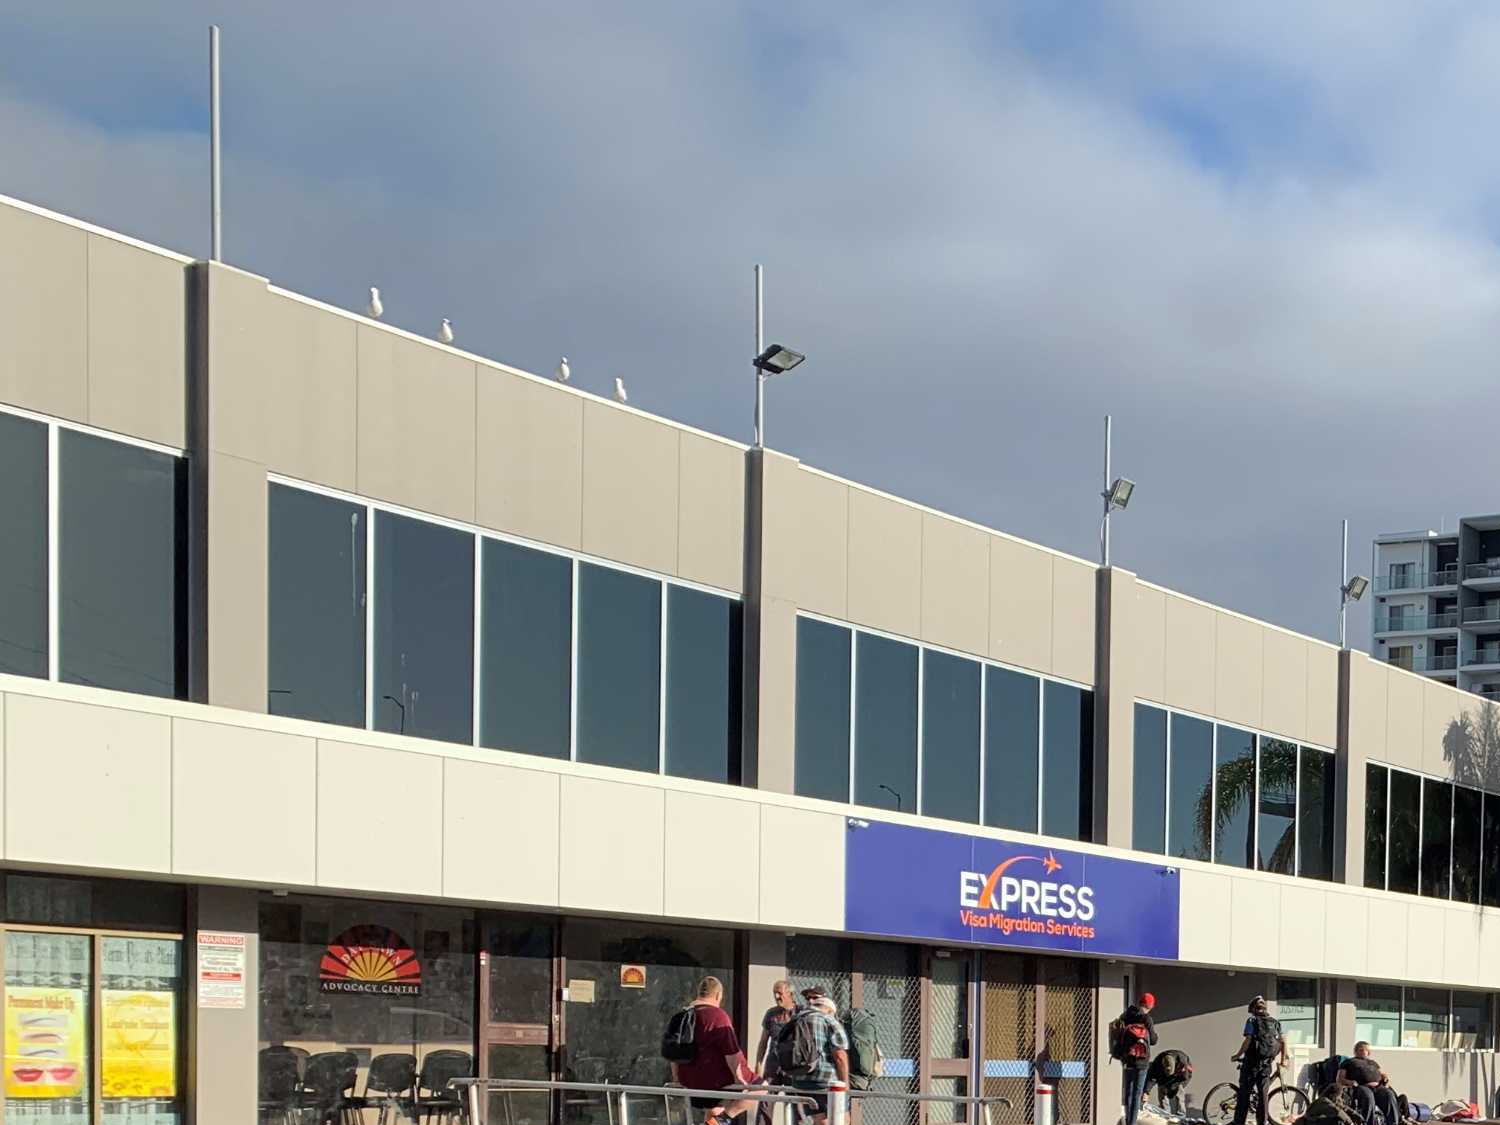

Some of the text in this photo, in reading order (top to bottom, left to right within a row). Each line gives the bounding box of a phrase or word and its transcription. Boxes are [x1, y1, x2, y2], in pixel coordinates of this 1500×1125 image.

[960, 871, 1095, 921] EXPRESS
[960, 910, 1095, 938] Visa Migration Services
[199, 935, 242, 945] WARNING
[321, 982, 419, 994] ADVOCACY CENTRE
